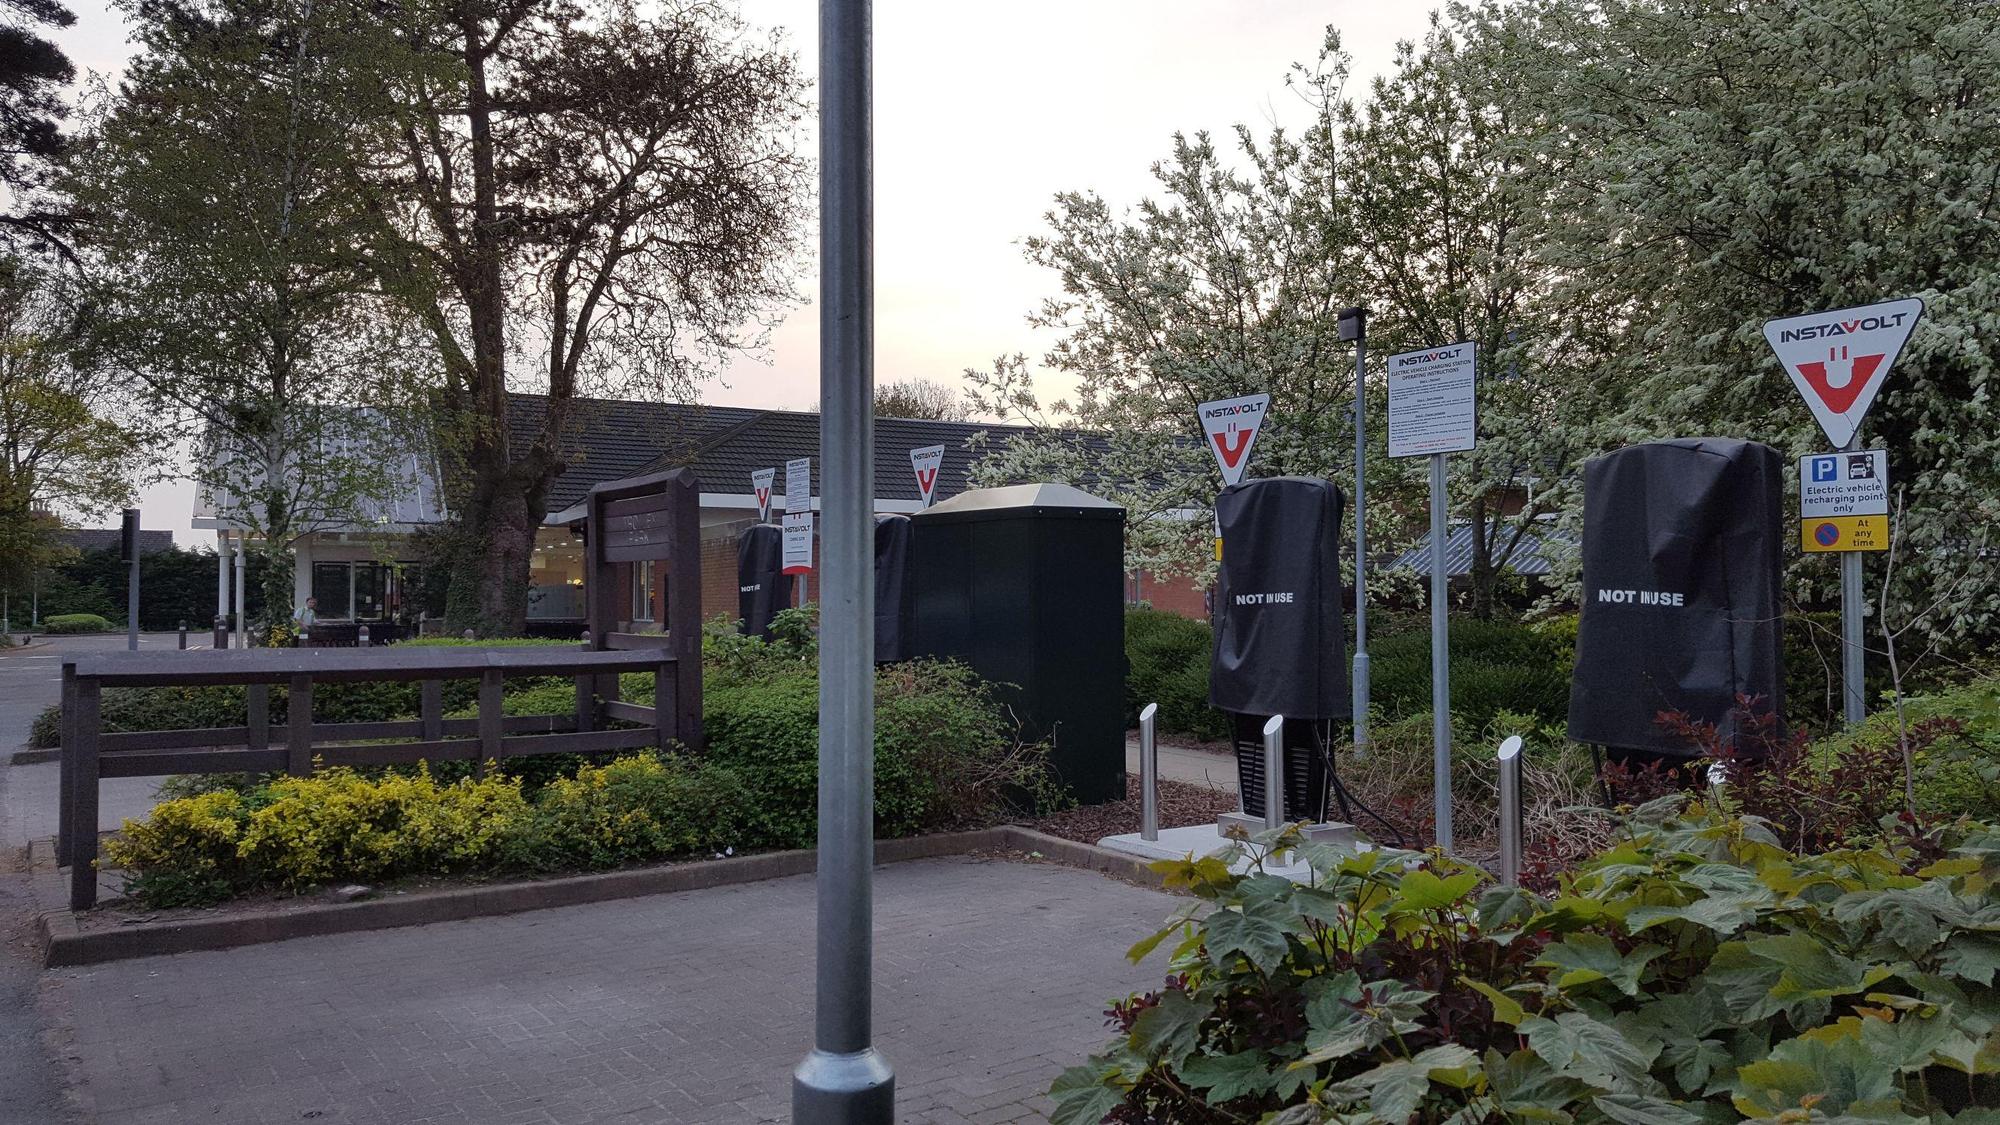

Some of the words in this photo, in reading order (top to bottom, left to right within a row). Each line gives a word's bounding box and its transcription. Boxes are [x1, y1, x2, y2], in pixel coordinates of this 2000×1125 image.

[1781, 313, 1907, 343] INSTAVOLT
[1398, 349, 1462, 367] INSTAVOLT
[1391, 368, 1410, 377] ELECTRIC
[1410, 365, 1428, 374] VEHICLE
[1428, 362, 1451, 371] CHARGING
[1452, 359, 1472, 367] STATION
[1402, 371, 1426, 380] OPERATING
[1427, 367, 1459, 377] INSTRUCTIONS
[1205, 402, 1264, 419] INSTAVOLT
[913, 450, 942, 460] INSTAVOLT
[1818, 460, 1833, 480] P
[1807, 486, 1844, 495] Electric
[1846, 483, 1881, 493] vehicle
[1804, 494, 1855, 505] recharging
[1858, 493, 1883, 503] point
[1833, 504, 1854, 513] only
[1857, 519, 1869, 527] At
[1854, 530, 1872, 538] any
[1853, 539, 1874, 547] time
[1236, 594, 1264, 605] NOT
[1598, 589, 1637, 604] NOT
